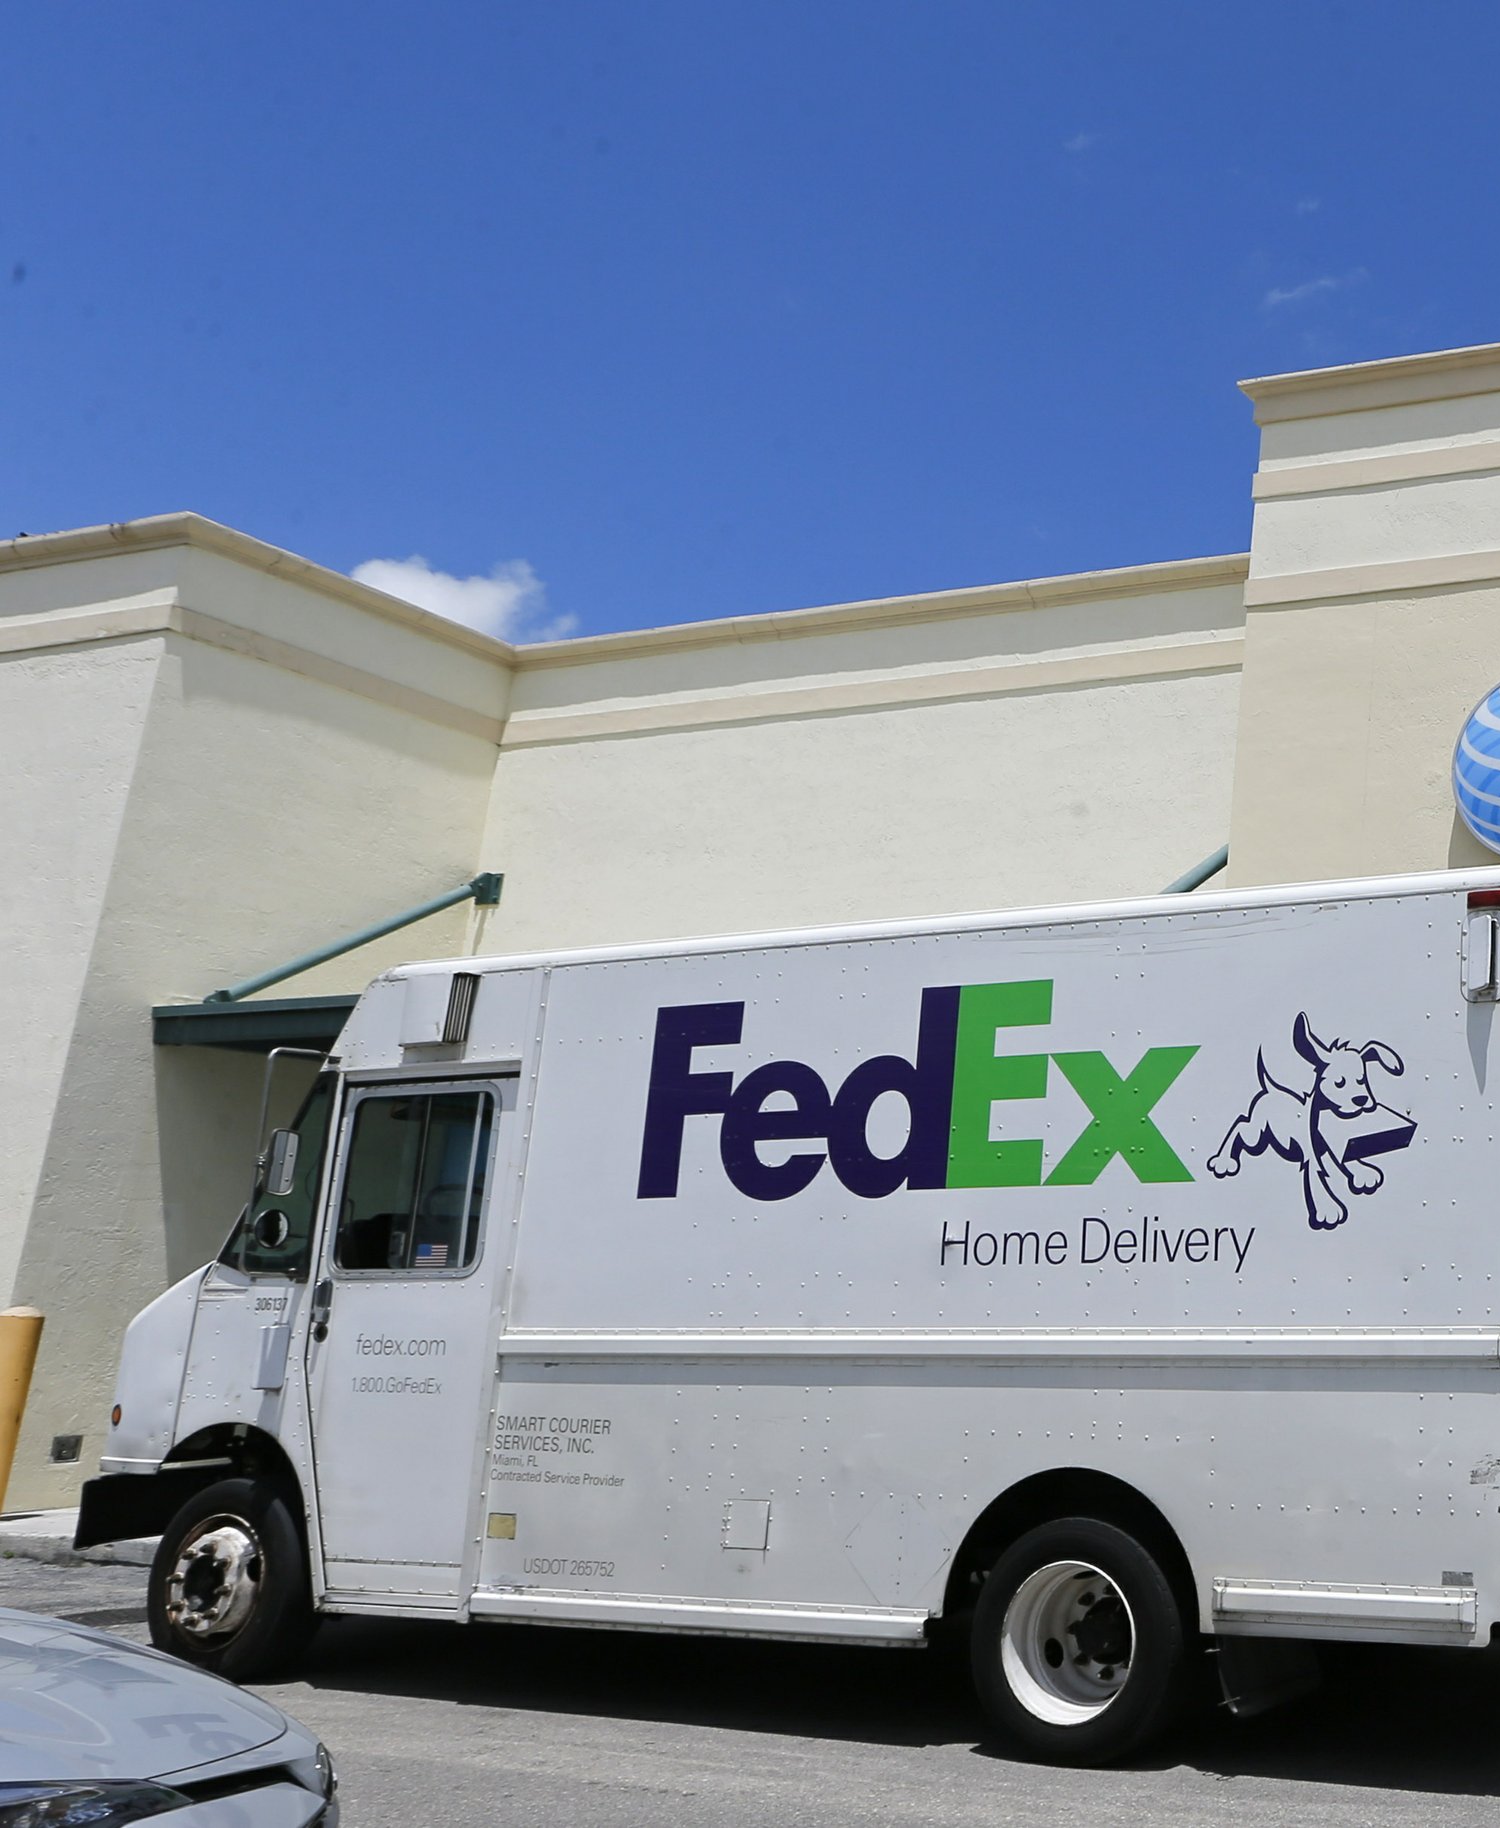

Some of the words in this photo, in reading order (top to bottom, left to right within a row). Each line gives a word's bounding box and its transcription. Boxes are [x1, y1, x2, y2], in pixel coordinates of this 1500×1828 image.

[637, 979, 1202, 1201] FedEx
[940, 1220, 1068, 1266] Home
[1080, 1216, 1256, 1273] Delivery
[255, 1297, 288, 1312] 306137
[356, 1333, 447, 1356] fedex.com
[352, 1376, 442, 1395] 1.800.GoFedEx
[496, 1415, 546, 1431] SMART
[549, 1417, 612, 1435] COURIER
[494, 1434, 562, 1454] SERVICES,
[567, 1437, 595, 1454] INC.
[492, 1454, 525, 1468] Miami,
[527, 1455, 539, 1467] FL
[490, 1468, 541, 1483] Contracted
[543, 1471, 580, 1485] Service
[583, 1473, 625, 1487] Provider
[523, 1558, 568, 1575] USDOT
[570, 1560, 615, 1577] 265752
